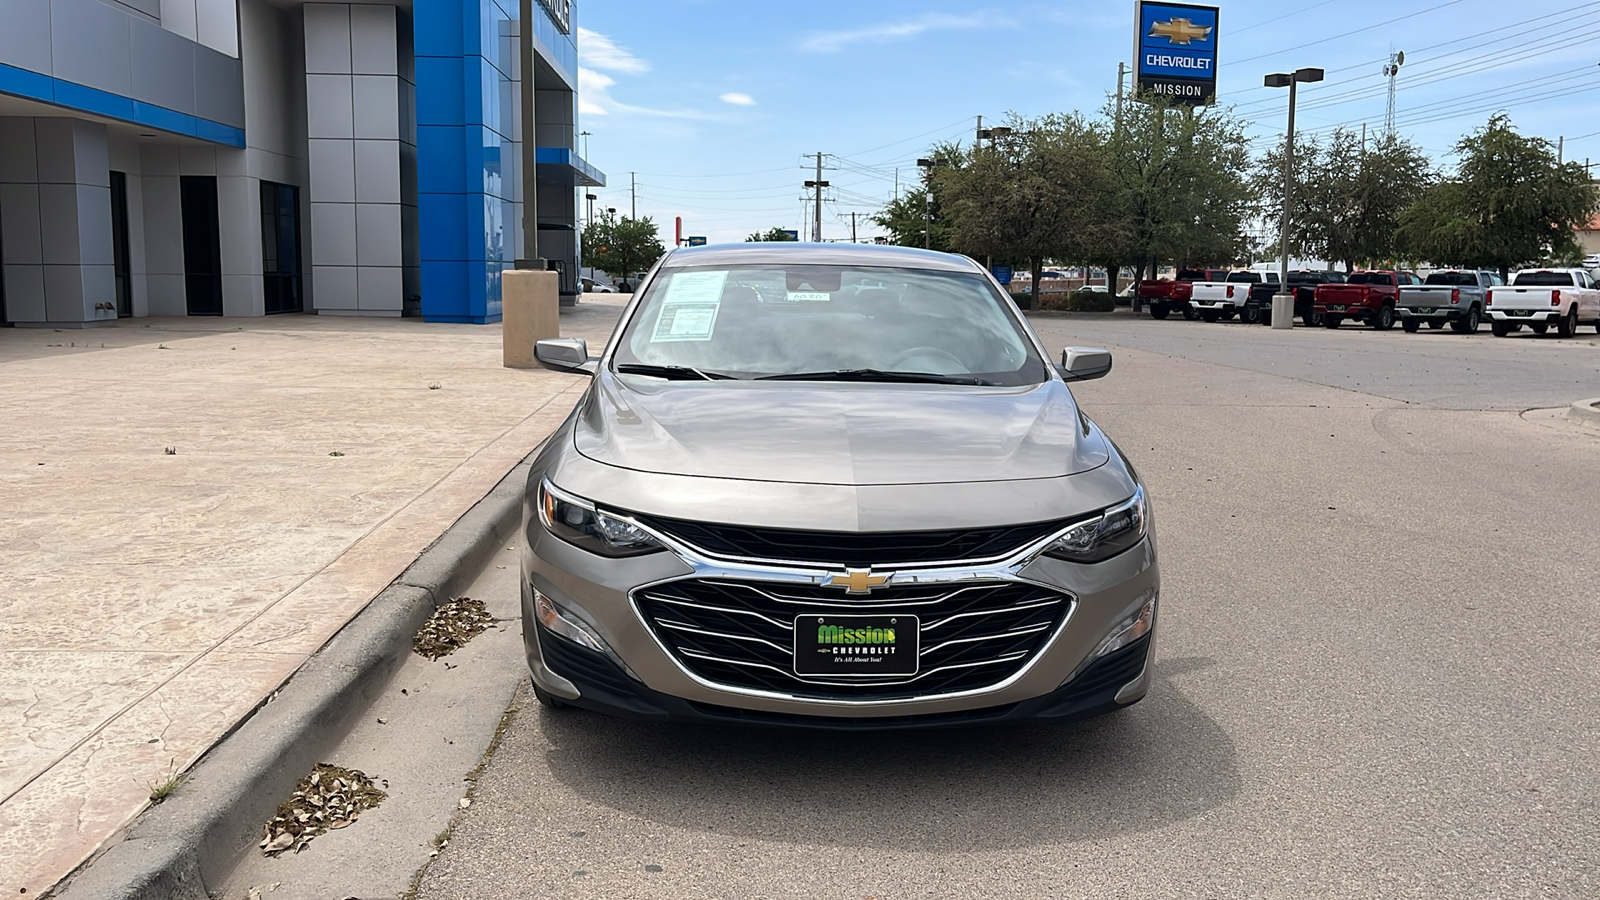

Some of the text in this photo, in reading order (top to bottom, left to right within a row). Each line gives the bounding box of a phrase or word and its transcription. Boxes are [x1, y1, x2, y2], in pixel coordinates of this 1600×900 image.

[1146, 54, 1211, 69] CHEVROLET
[1153, 83, 1201, 96] MISSION
[817, 624, 896, 644] Mission
